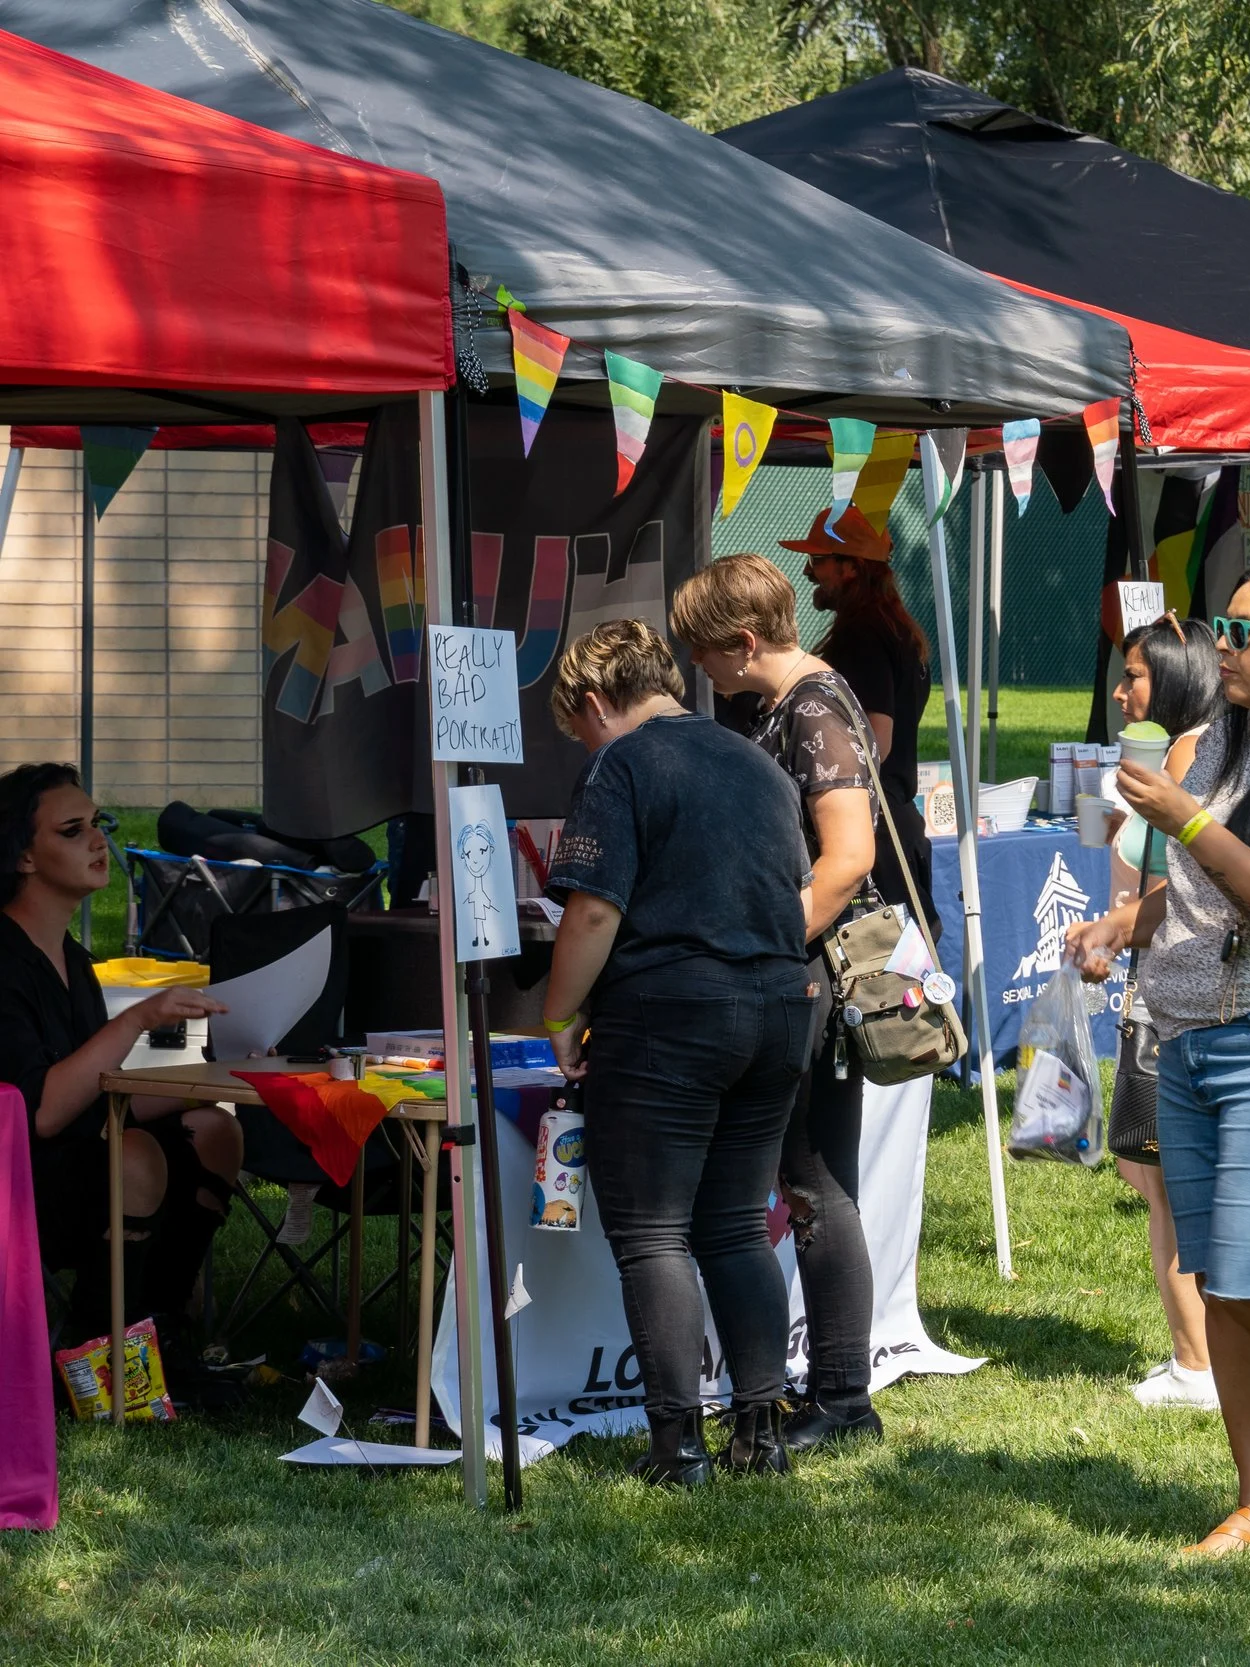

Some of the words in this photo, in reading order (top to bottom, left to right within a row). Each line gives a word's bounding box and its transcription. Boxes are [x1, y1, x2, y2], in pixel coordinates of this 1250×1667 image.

[1123, 585, 1160, 614] REALLY
[434, 632, 504, 674] REALLY
[437, 674, 486, 709] BAD
[437, 716, 521, 759] PORTRAITS
[1002, 985, 1034, 1004] SEXUAL
